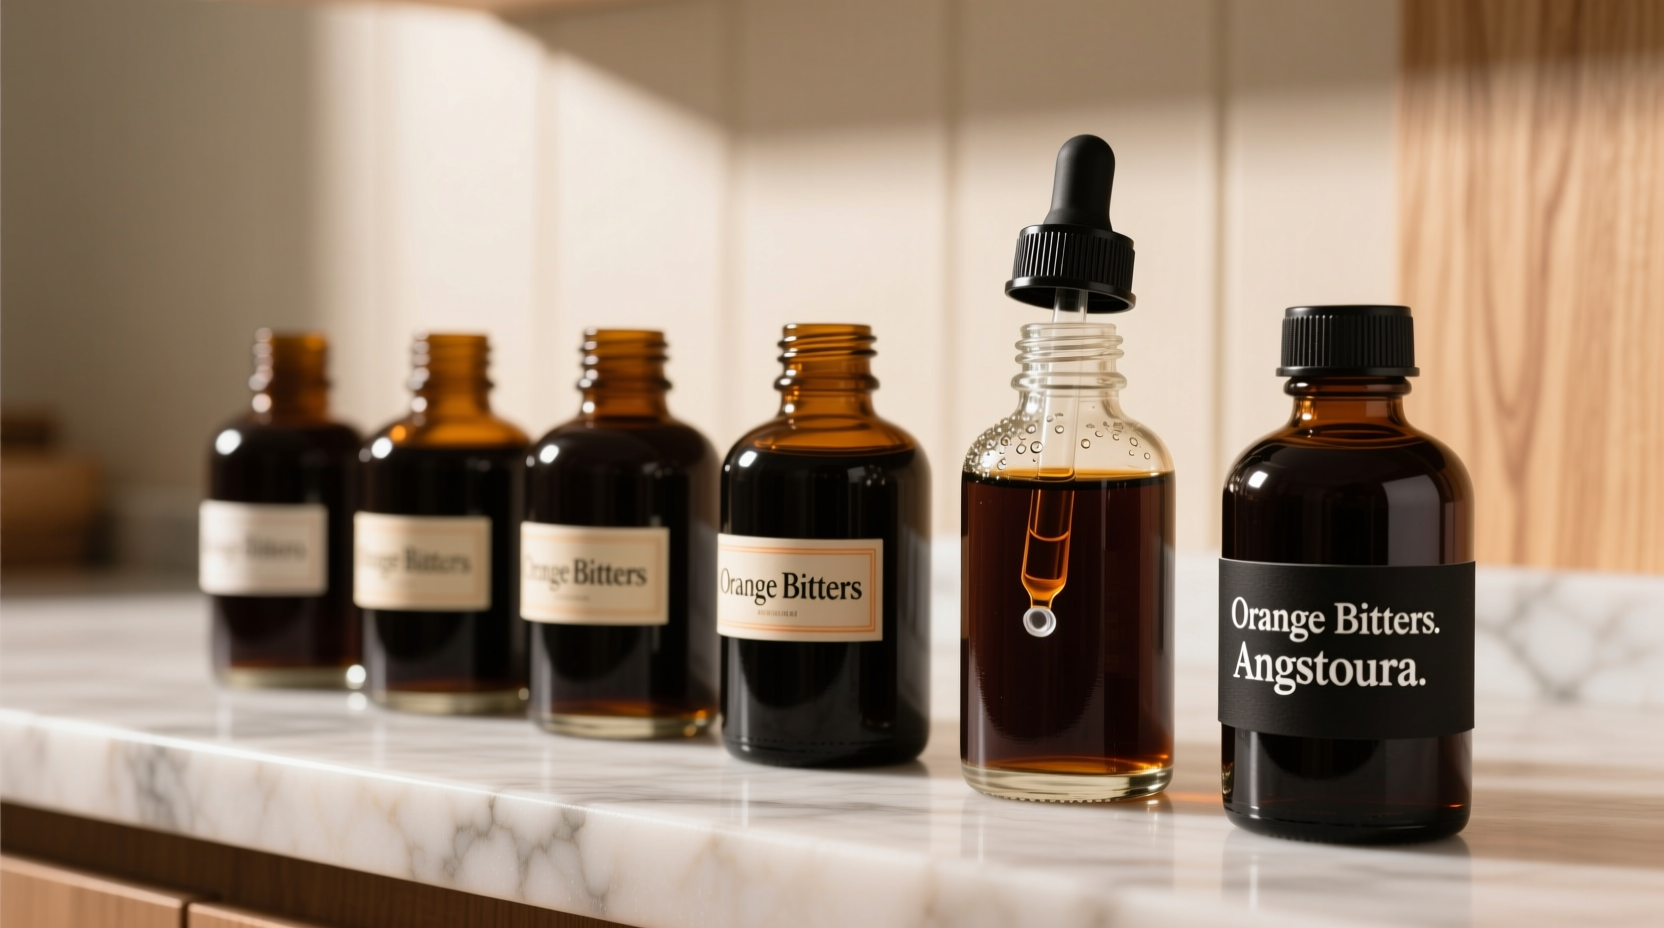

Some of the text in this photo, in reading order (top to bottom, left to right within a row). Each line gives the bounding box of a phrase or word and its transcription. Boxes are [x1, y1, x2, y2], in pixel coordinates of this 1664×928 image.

[573, 558, 648, 587] Bitters
[720, 567, 863, 606] Orange Bitters
[1231, 596, 1441, 643] Orange Bitters.
[1232, 640, 1427, 696] Angstoura.
